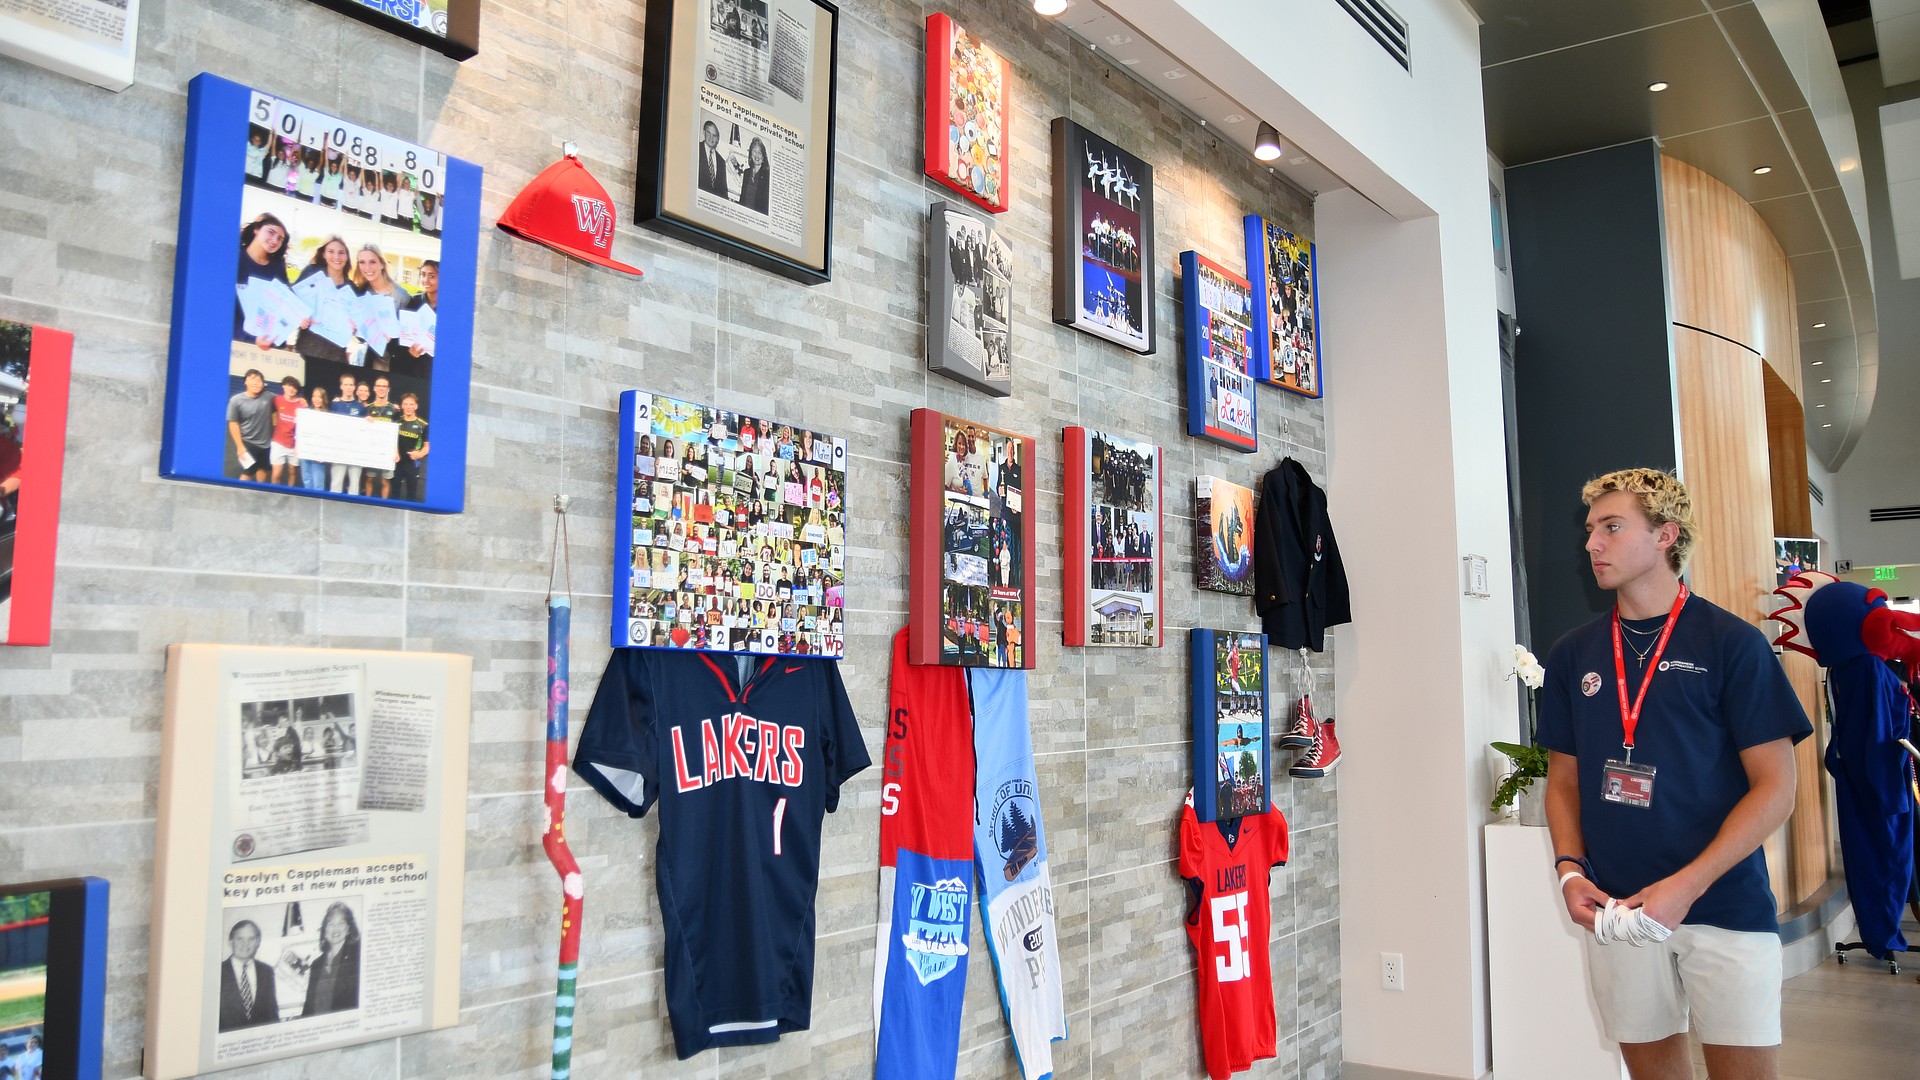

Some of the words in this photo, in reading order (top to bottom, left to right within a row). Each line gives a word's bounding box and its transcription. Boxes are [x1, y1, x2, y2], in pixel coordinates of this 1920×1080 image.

[700, 85, 729, 105] Carolyn
[732, 101, 770, 125] Cappleman
[772, 122, 798, 139] accepts
[700, 94, 714, 107] key
[716, 104, 732, 115] post
[743, 117, 758, 127] new
[760, 125, 783, 140] private
[784, 136, 805, 150] school
[571, 194, 613, 248] WP
[640, 404, 649, 420] 2
[1875, 566, 1897, 580] EXIT
[823, 635, 843, 656] WP
[671, 712, 805, 794] LAKERS
[1000, 785, 1010, 800] OF
[772, 798, 787, 855] 1
[223, 871, 279, 885] Carolyn
[287, 866, 360, 883] Cappleman
[366, 861, 414, 874] accepts
[223, 887, 249, 899] key
[255, 884, 285, 897] post
[292, 882, 305, 891] at
[310, 880, 337, 890] new
[342, 876, 385, 889] private
[390, 871, 428, 883] school
[928, 889, 968, 922] WEST
